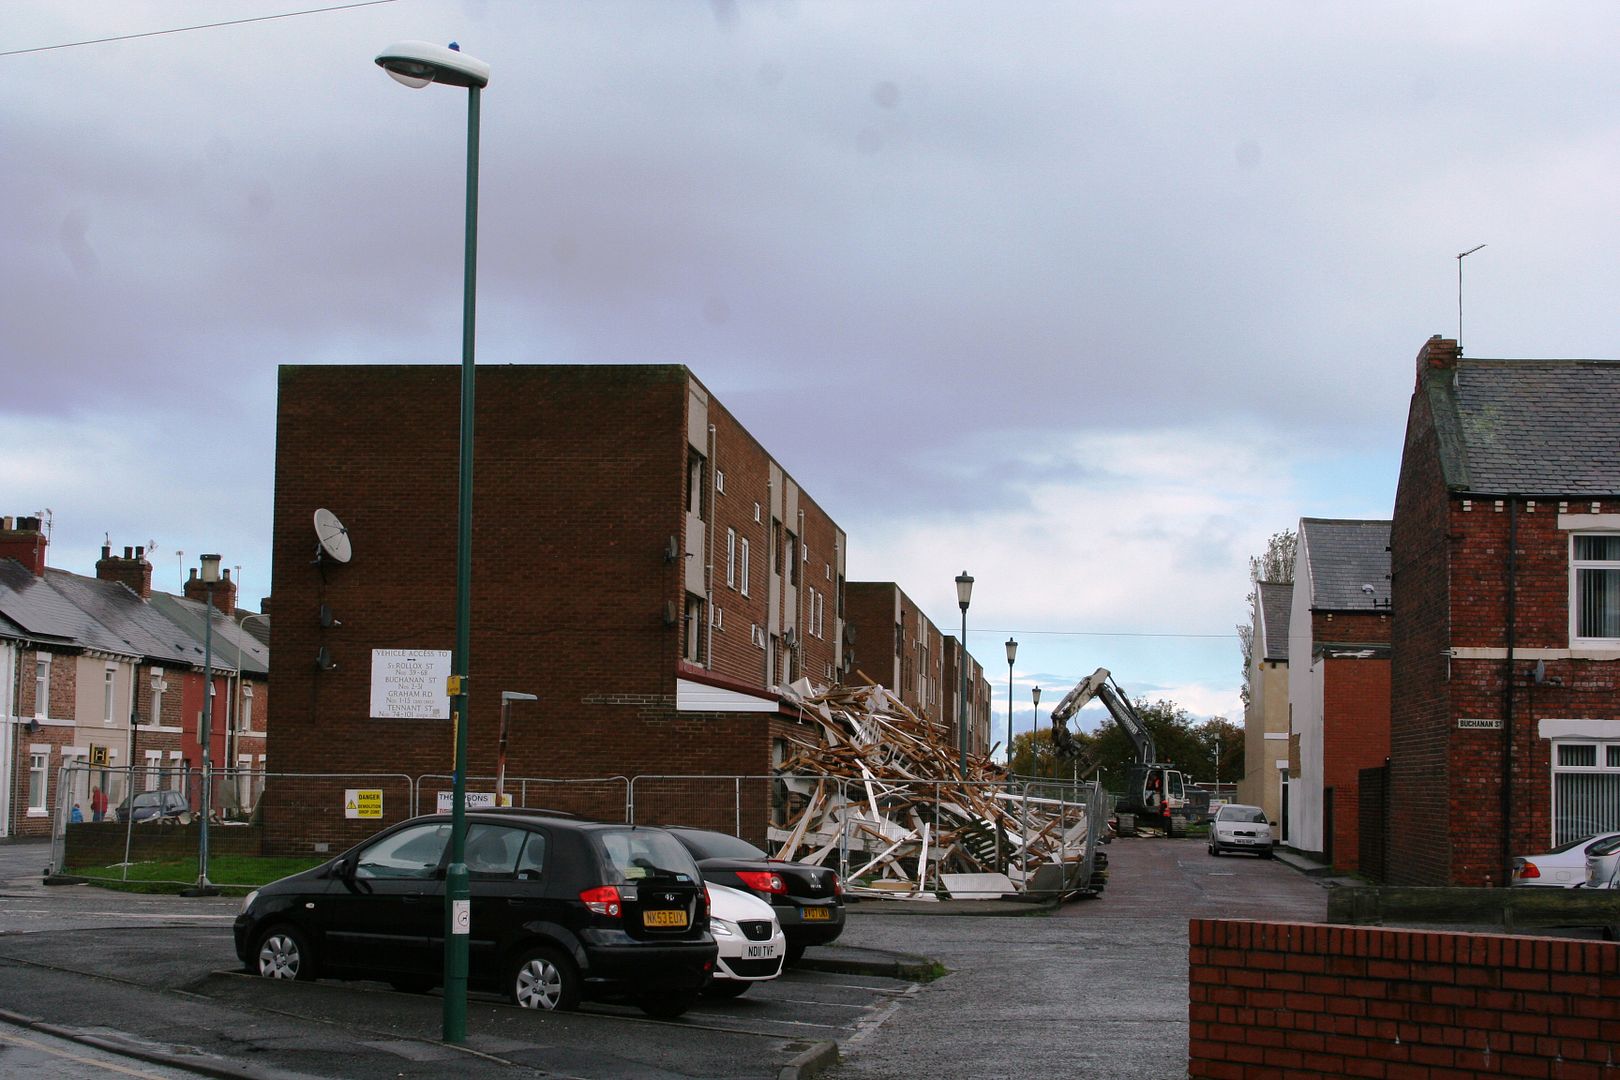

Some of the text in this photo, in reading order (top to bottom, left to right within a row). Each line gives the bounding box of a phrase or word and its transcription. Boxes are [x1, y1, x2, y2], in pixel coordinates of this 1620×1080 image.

[1460, 720, 1494, 728] BUCHANAN
[646, 911, 684, 924] NK53 EUX
[763, 945, 774, 957] TVF
